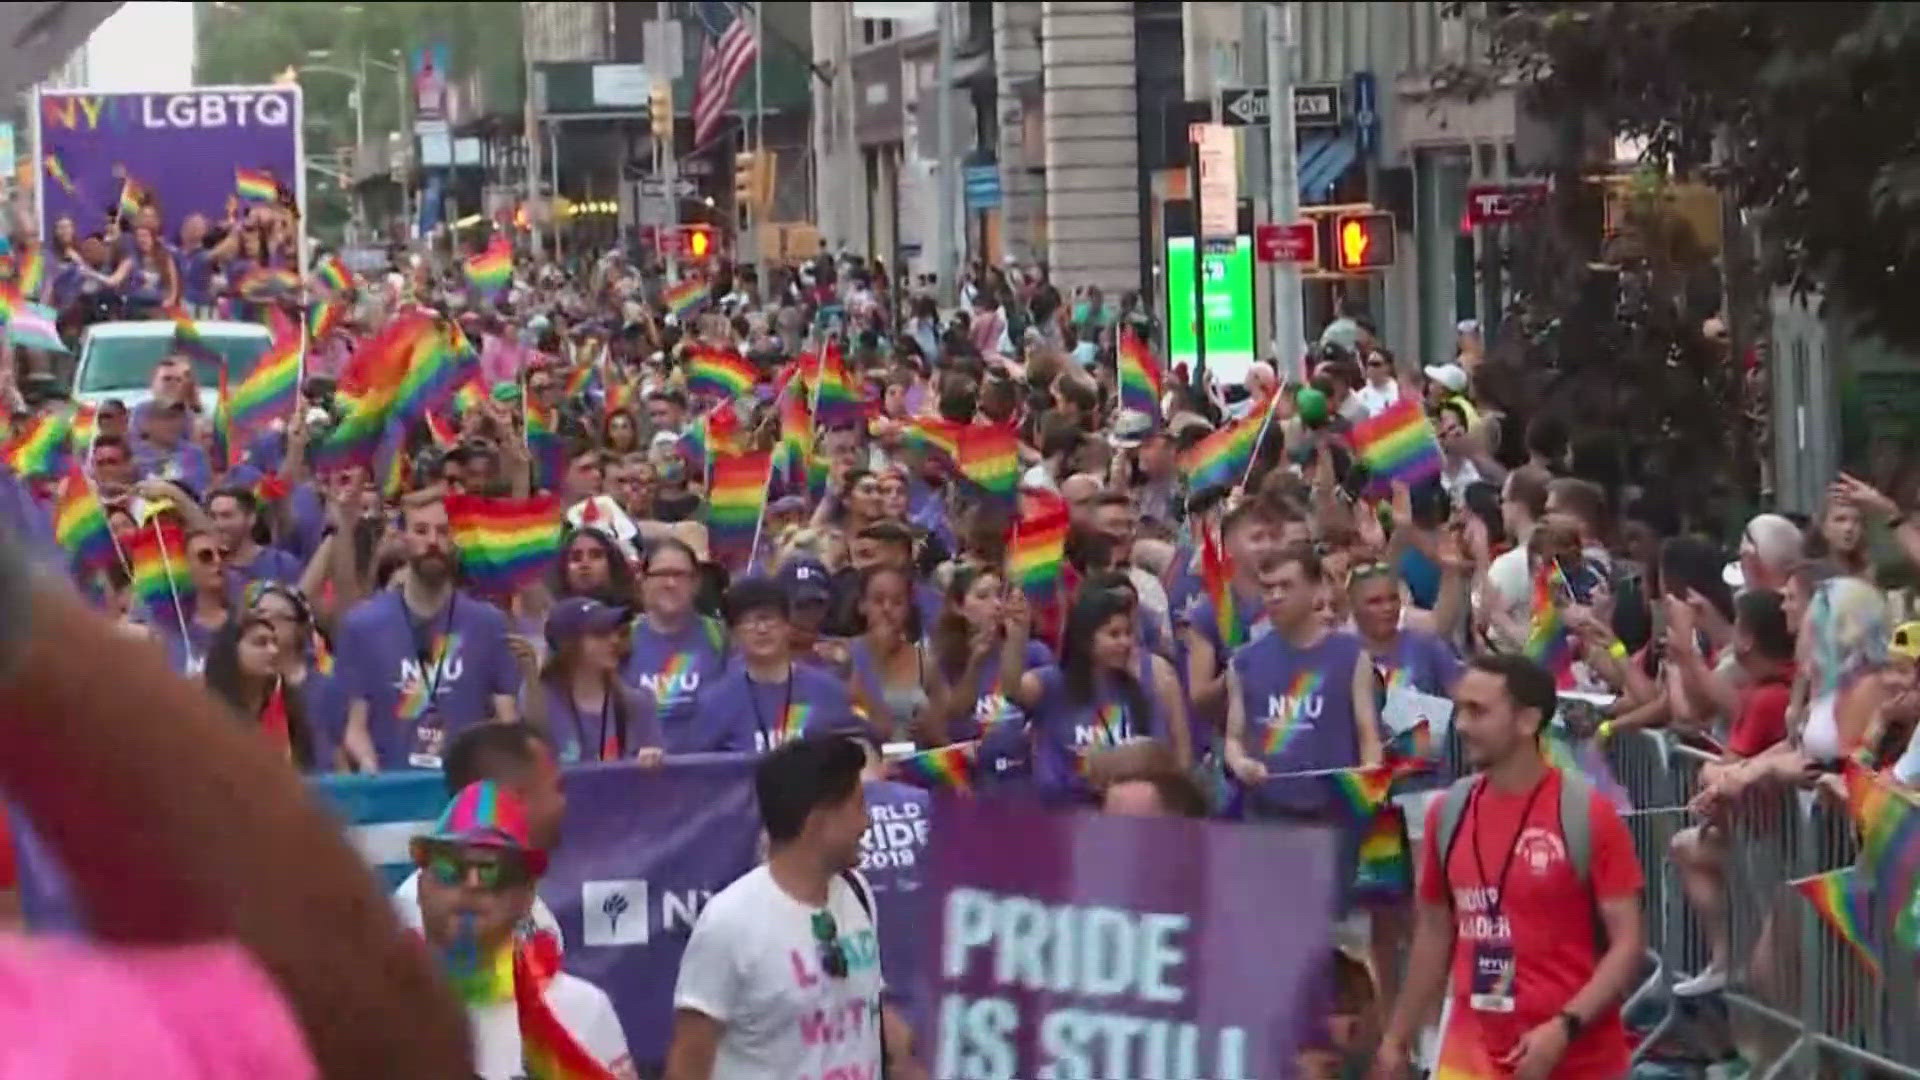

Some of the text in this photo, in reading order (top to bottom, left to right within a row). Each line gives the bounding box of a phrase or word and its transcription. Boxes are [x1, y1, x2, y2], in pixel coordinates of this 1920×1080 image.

[143, 94, 288, 128] LGBTQ
[401, 658, 463, 682] NYU
[640, 672, 699, 692] NYU
[1269, 694, 1324, 720] NYU
[871, 803, 921, 821] RLD
[943, 886, 1190, 1002] PRIDE
[935, 994, 1019, 1080] IS
